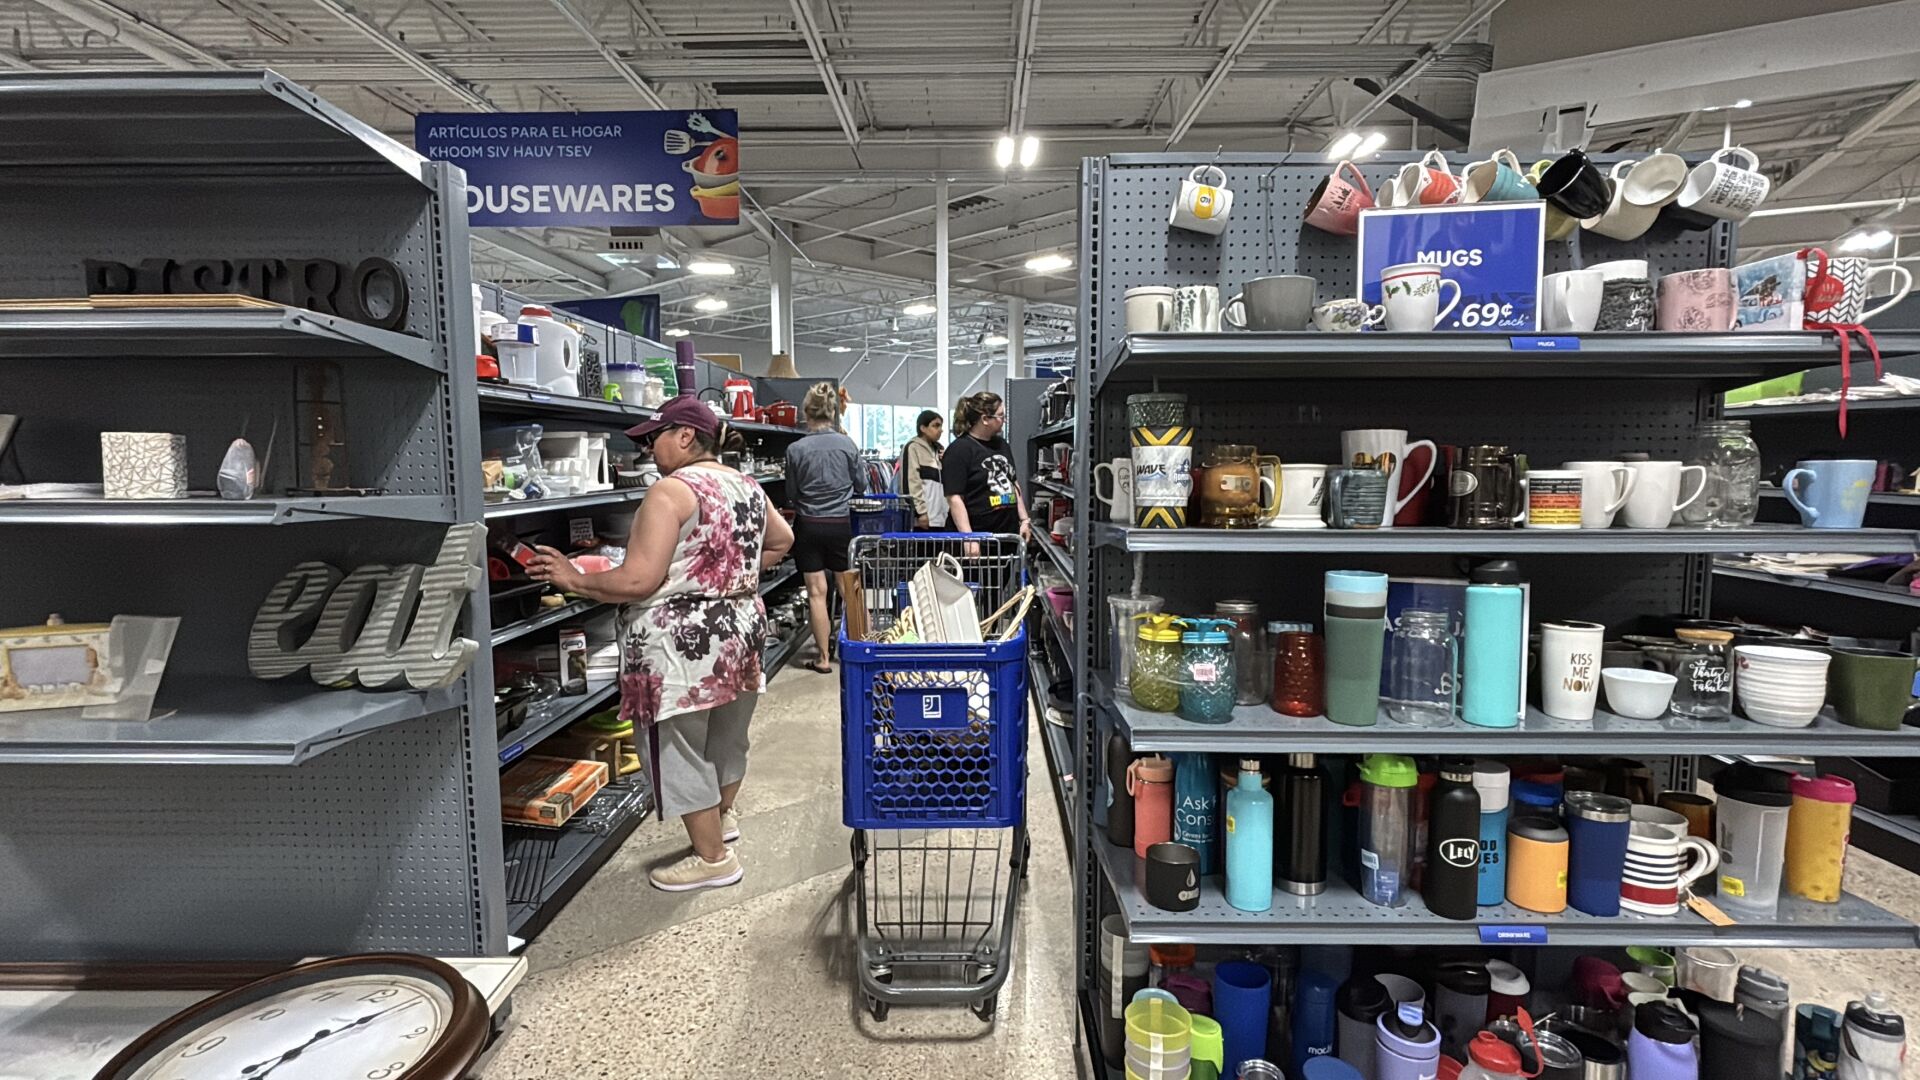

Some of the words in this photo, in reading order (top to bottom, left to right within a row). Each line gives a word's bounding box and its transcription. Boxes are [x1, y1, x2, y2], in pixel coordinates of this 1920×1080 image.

[428, 126, 507, 139] ARTÍCULOS
[511, 126, 549, 138] PARA
[552, 126, 568, 138] EL
[571, 125, 622, 138] HOGAR
[429, 146, 483, 158] KHOOM
[486, 146, 509, 158] SIV
[513, 146, 552, 157] HAUV
[557, 145, 592, 157] TSEV
[467, 183, 676, 214] OUSEWARES
[1417, 249, 1483, 267] MUGS
[1136, 464, 1166, 475] WAVE
[248, 521, 489, 690] eat
[1570, 653, 1593, 666] KISS
[1572, 666, 1590, 680] ME
[1562, 677, 1594, 693] NOW
[1182, 795, 1210, 811] Ask
[1176, 808, 1213, 826] Cons
[1449, 843, 1476, 861] LELY
[356, 989, 399, 1003] 12
[400, 1026, 428, 1039] 2
[181, 1035, 227, 1059] 9
[366, 1061, 406, 1080] 3
